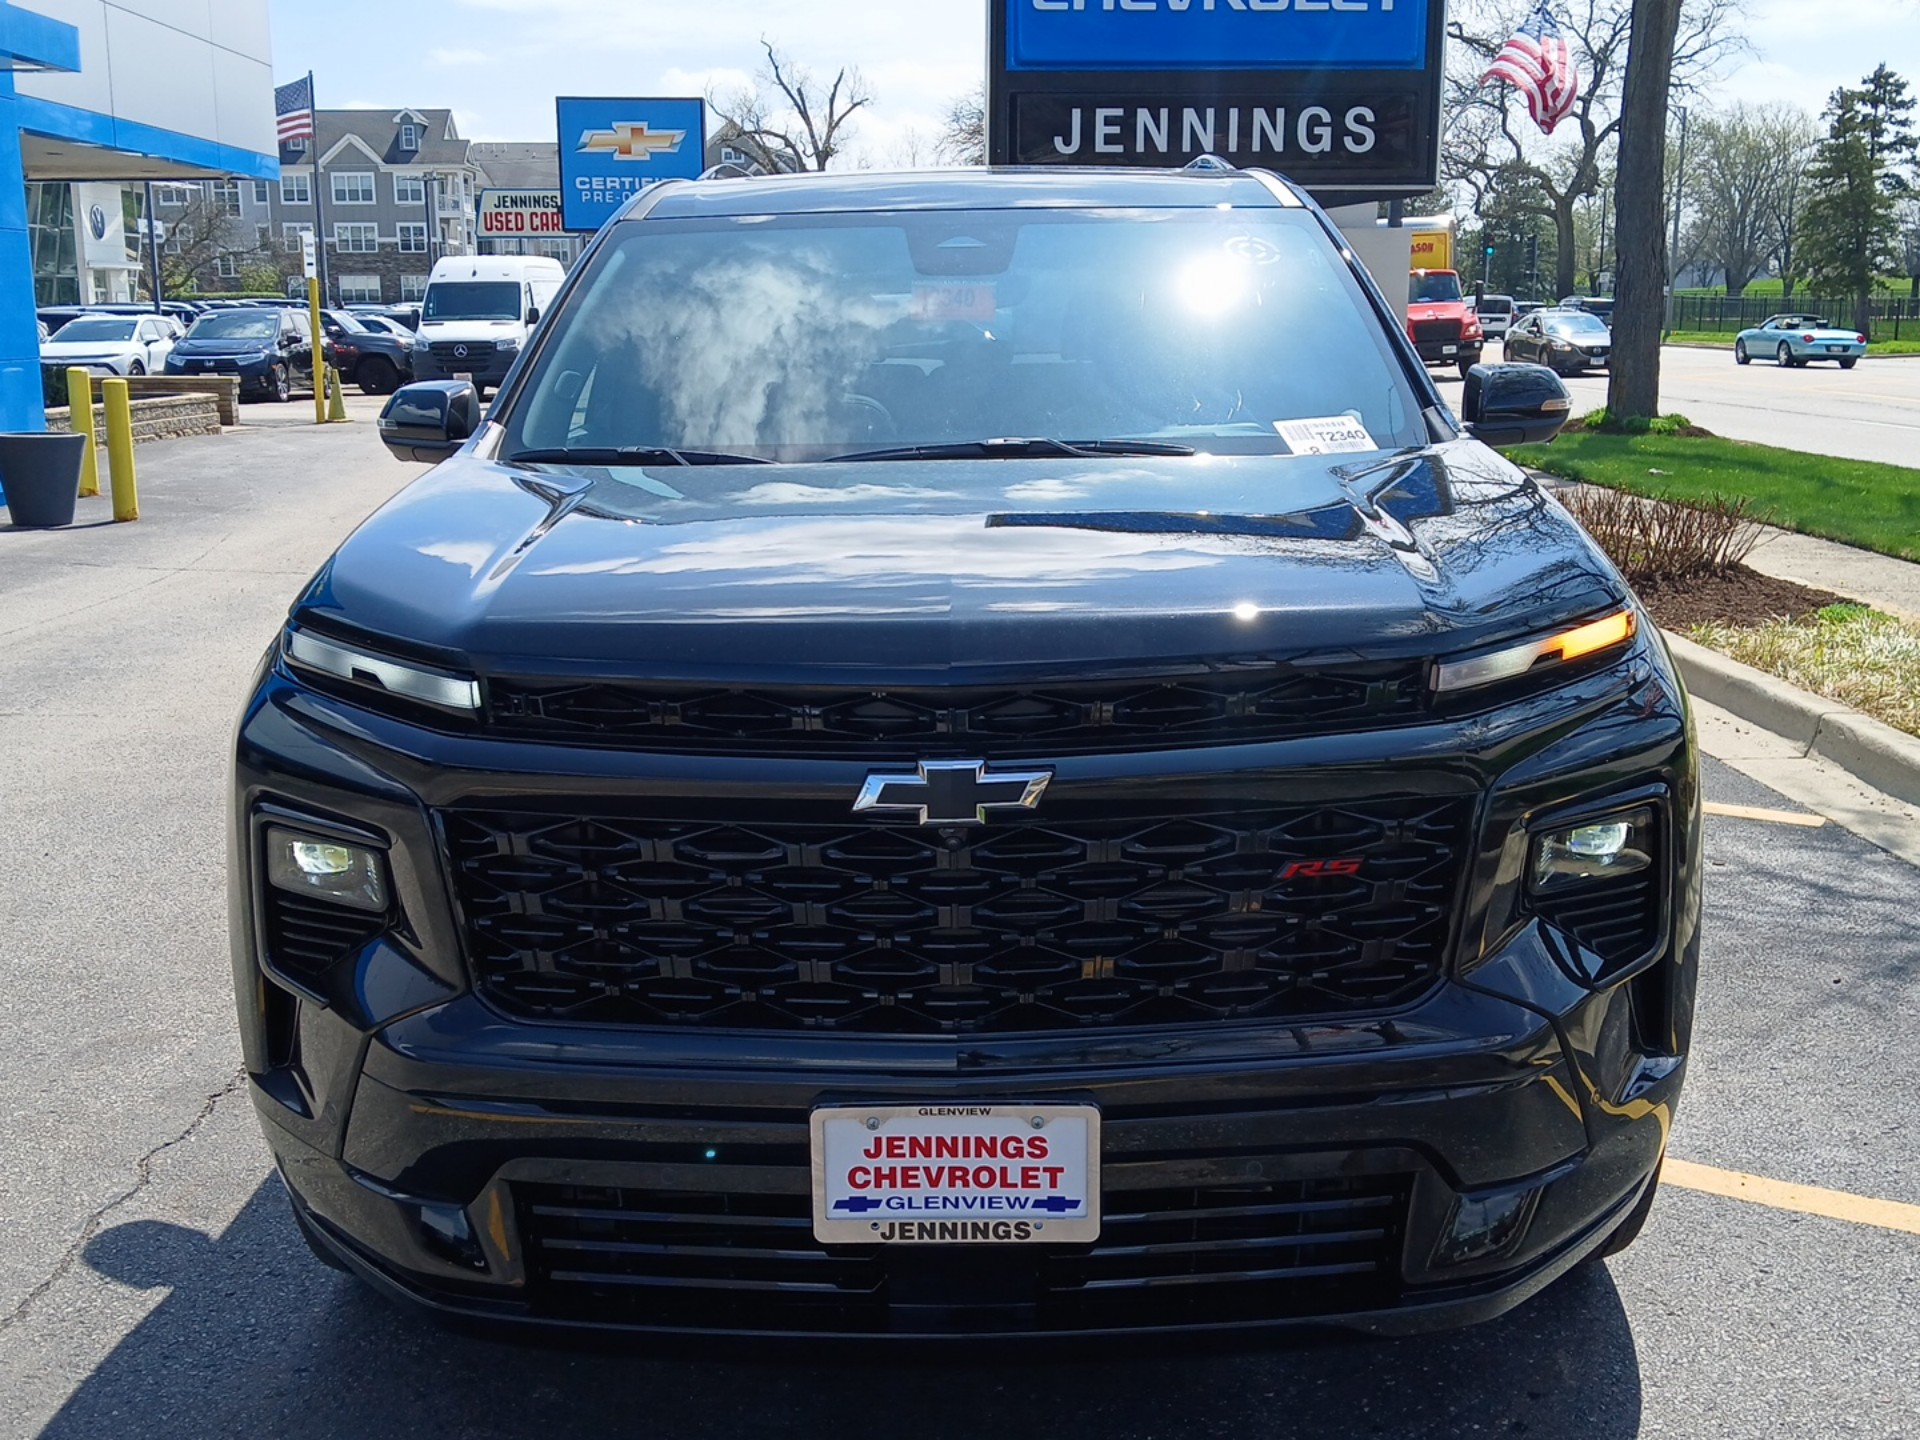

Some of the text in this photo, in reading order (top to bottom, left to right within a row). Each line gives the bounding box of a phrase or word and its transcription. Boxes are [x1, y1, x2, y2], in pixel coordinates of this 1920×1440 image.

[1053, 106, 1376, 154] JENNINGS
[494, 195, 558, 209] JENNINGS
[581, 191, 635, 203] PRE-O
[483, 211, 562, 231] USED CAR
[1314, 430, 1366, 442] T2340
[1280, 858, 1363, 879] RS
[918, 1107, 991, 1116] GLENVIEW
[863, 1135, 1049, 1159] JENNINGS
[847, 1166, 1065, 1189] CHEVROLET
[886, 1195, 1030, 1210] GLENVIEW
[880, 1221, 1032, 1240] JENNINGS
